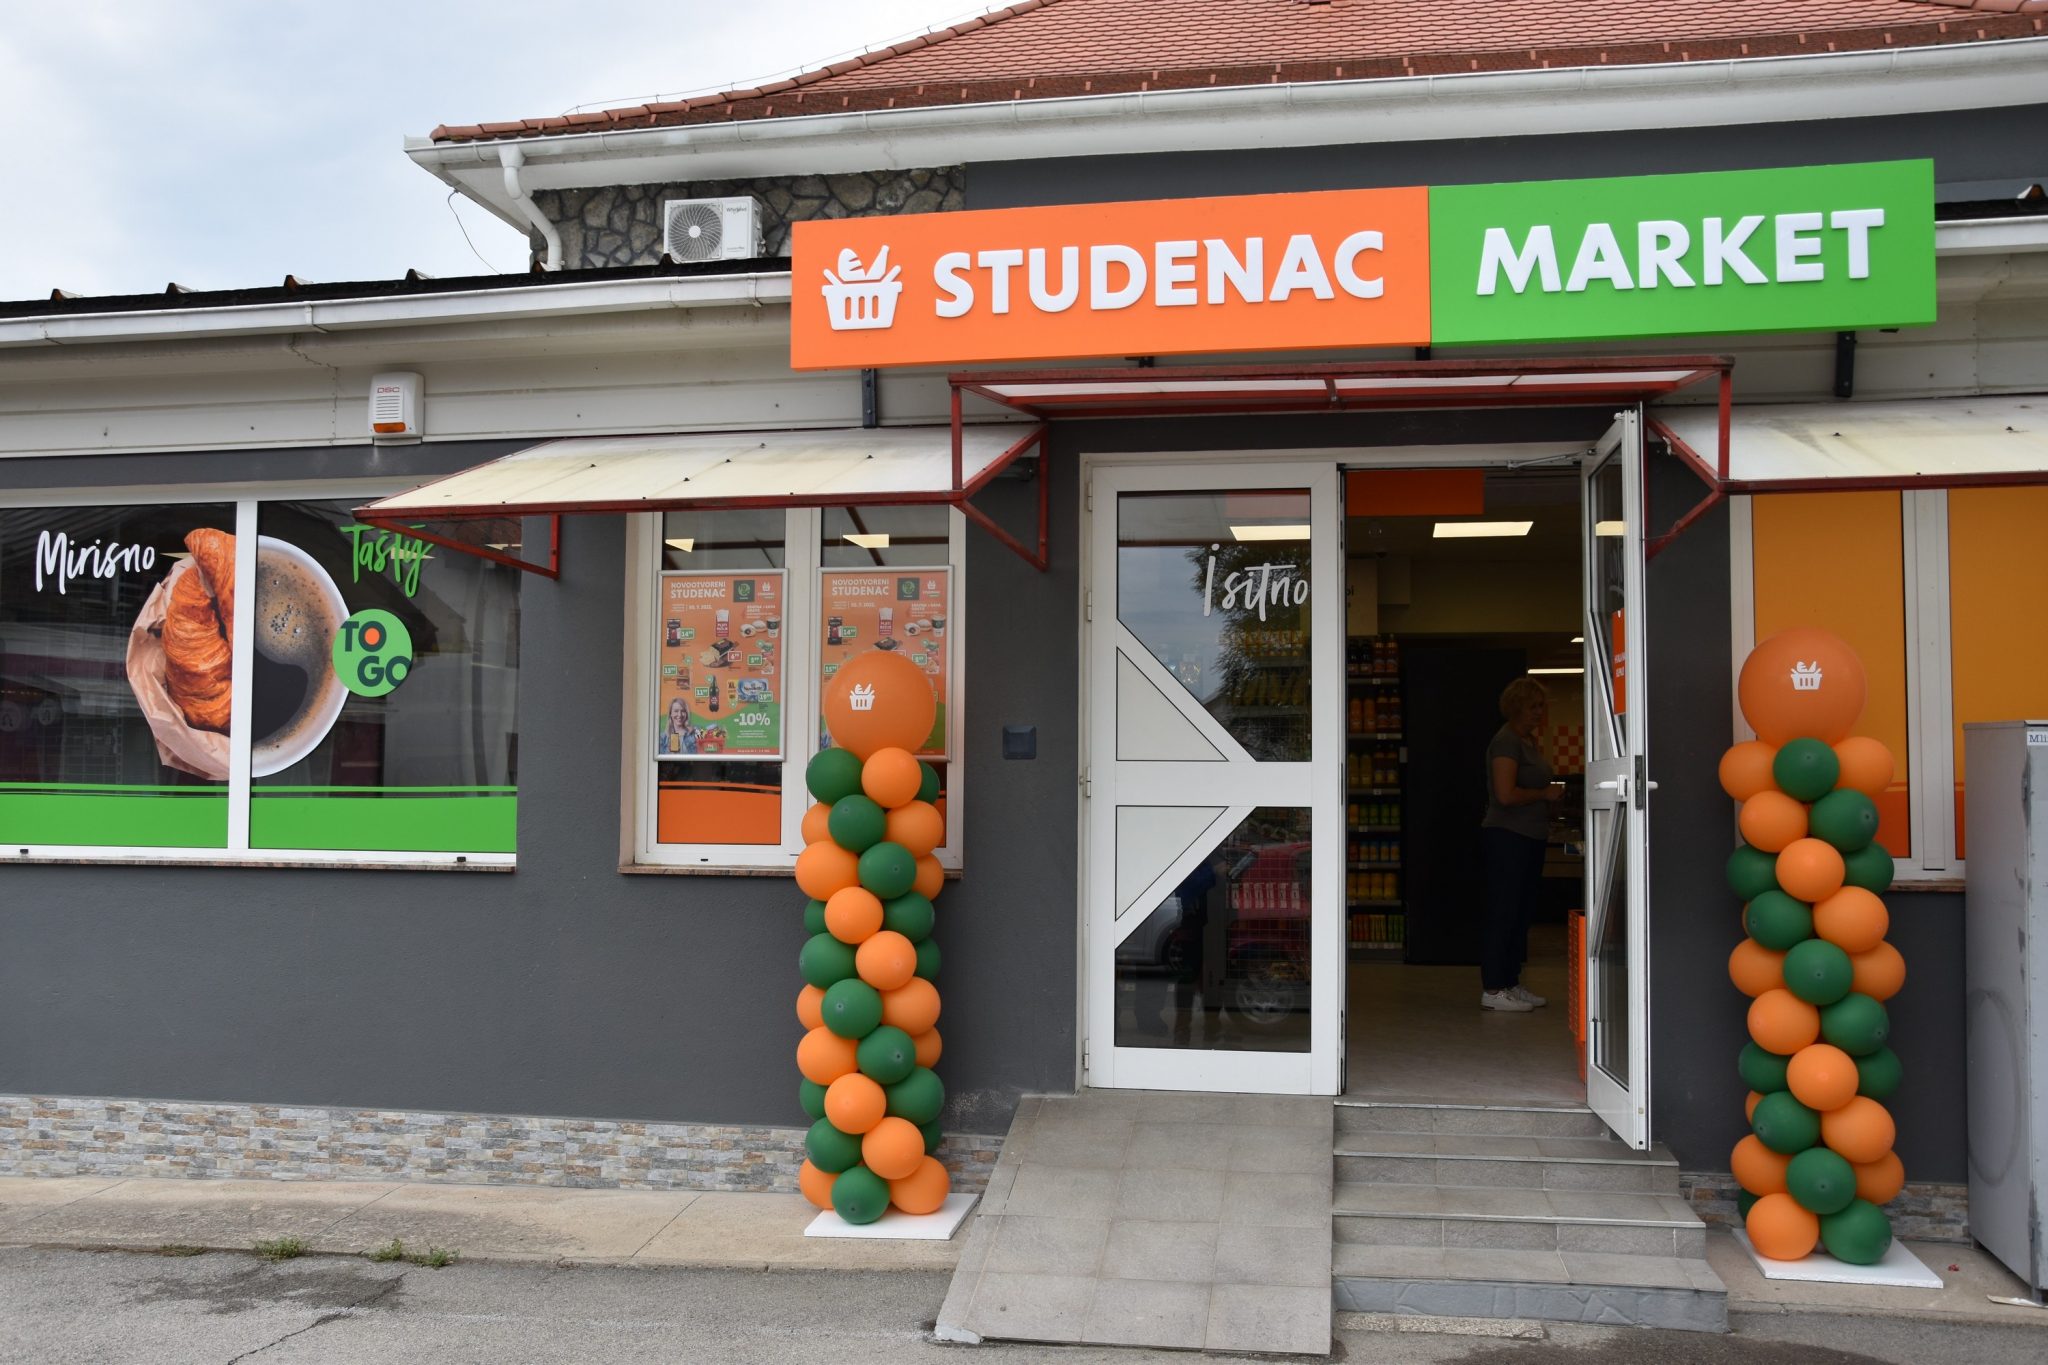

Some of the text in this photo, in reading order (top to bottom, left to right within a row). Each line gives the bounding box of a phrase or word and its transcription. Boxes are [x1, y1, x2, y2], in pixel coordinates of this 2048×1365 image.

[934, 208, 1884, 317] STUDENAC MARKET
[36, 530, 156, 595] Mirisno
[340, 524, 434, 598] Tasty
[671, 581, 726, 589] NOVOOTVORENI
[832, 578, 889, 586] NOVOOTVORENI
[832, 586, 889, 596] STUDENAC
[671, 589, 726, 599] STUDENAC
[341, 620, 387, 653] TO
[357, 655, 412, 688] GO
[734, 713, 771, 726] -10%
